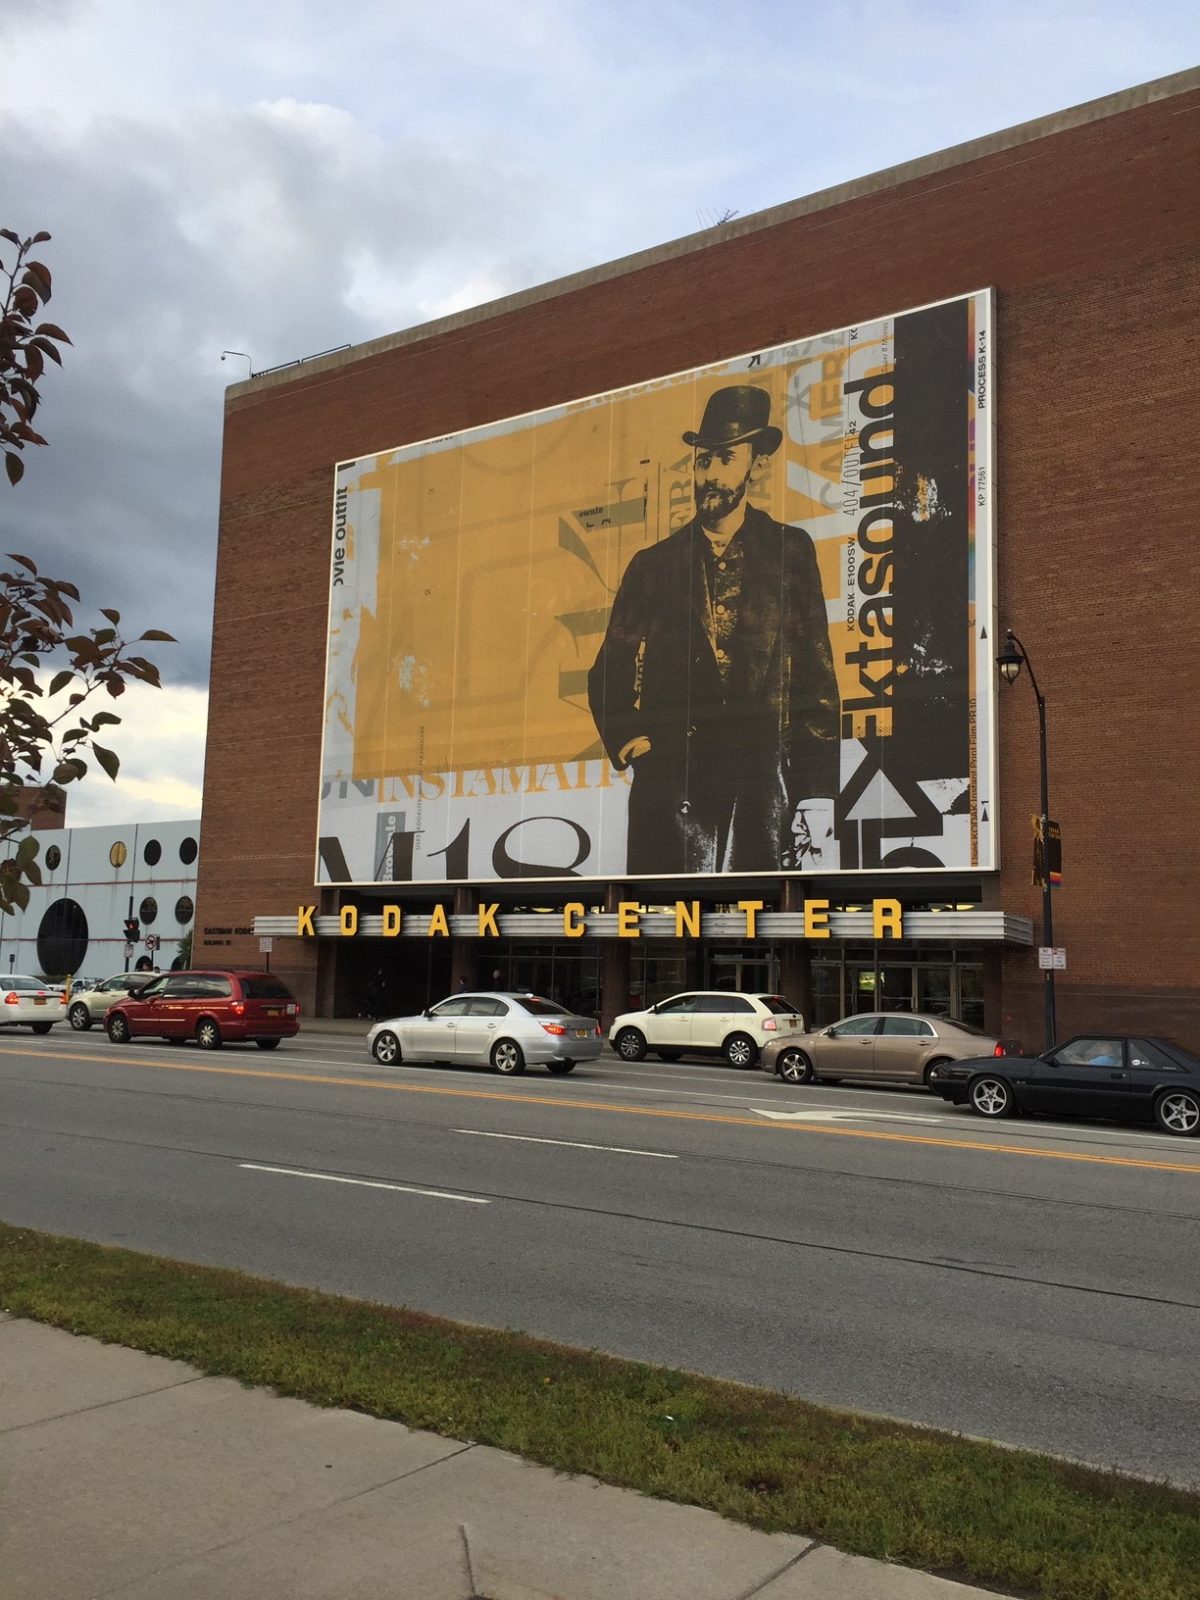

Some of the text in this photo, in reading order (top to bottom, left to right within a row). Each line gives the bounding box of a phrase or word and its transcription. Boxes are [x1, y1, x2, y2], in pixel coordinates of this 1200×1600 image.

[977, 329, 986, 408] PROCESS K-14
[978, 493, 986, 506] KP
[841, 374, 896, 739] Ektasound
[847, 536, 857, 631] KODAK E100SW
[970, 804, 978, 839] KODAK
[298, 898, 904, 939] KODAK CENTER
